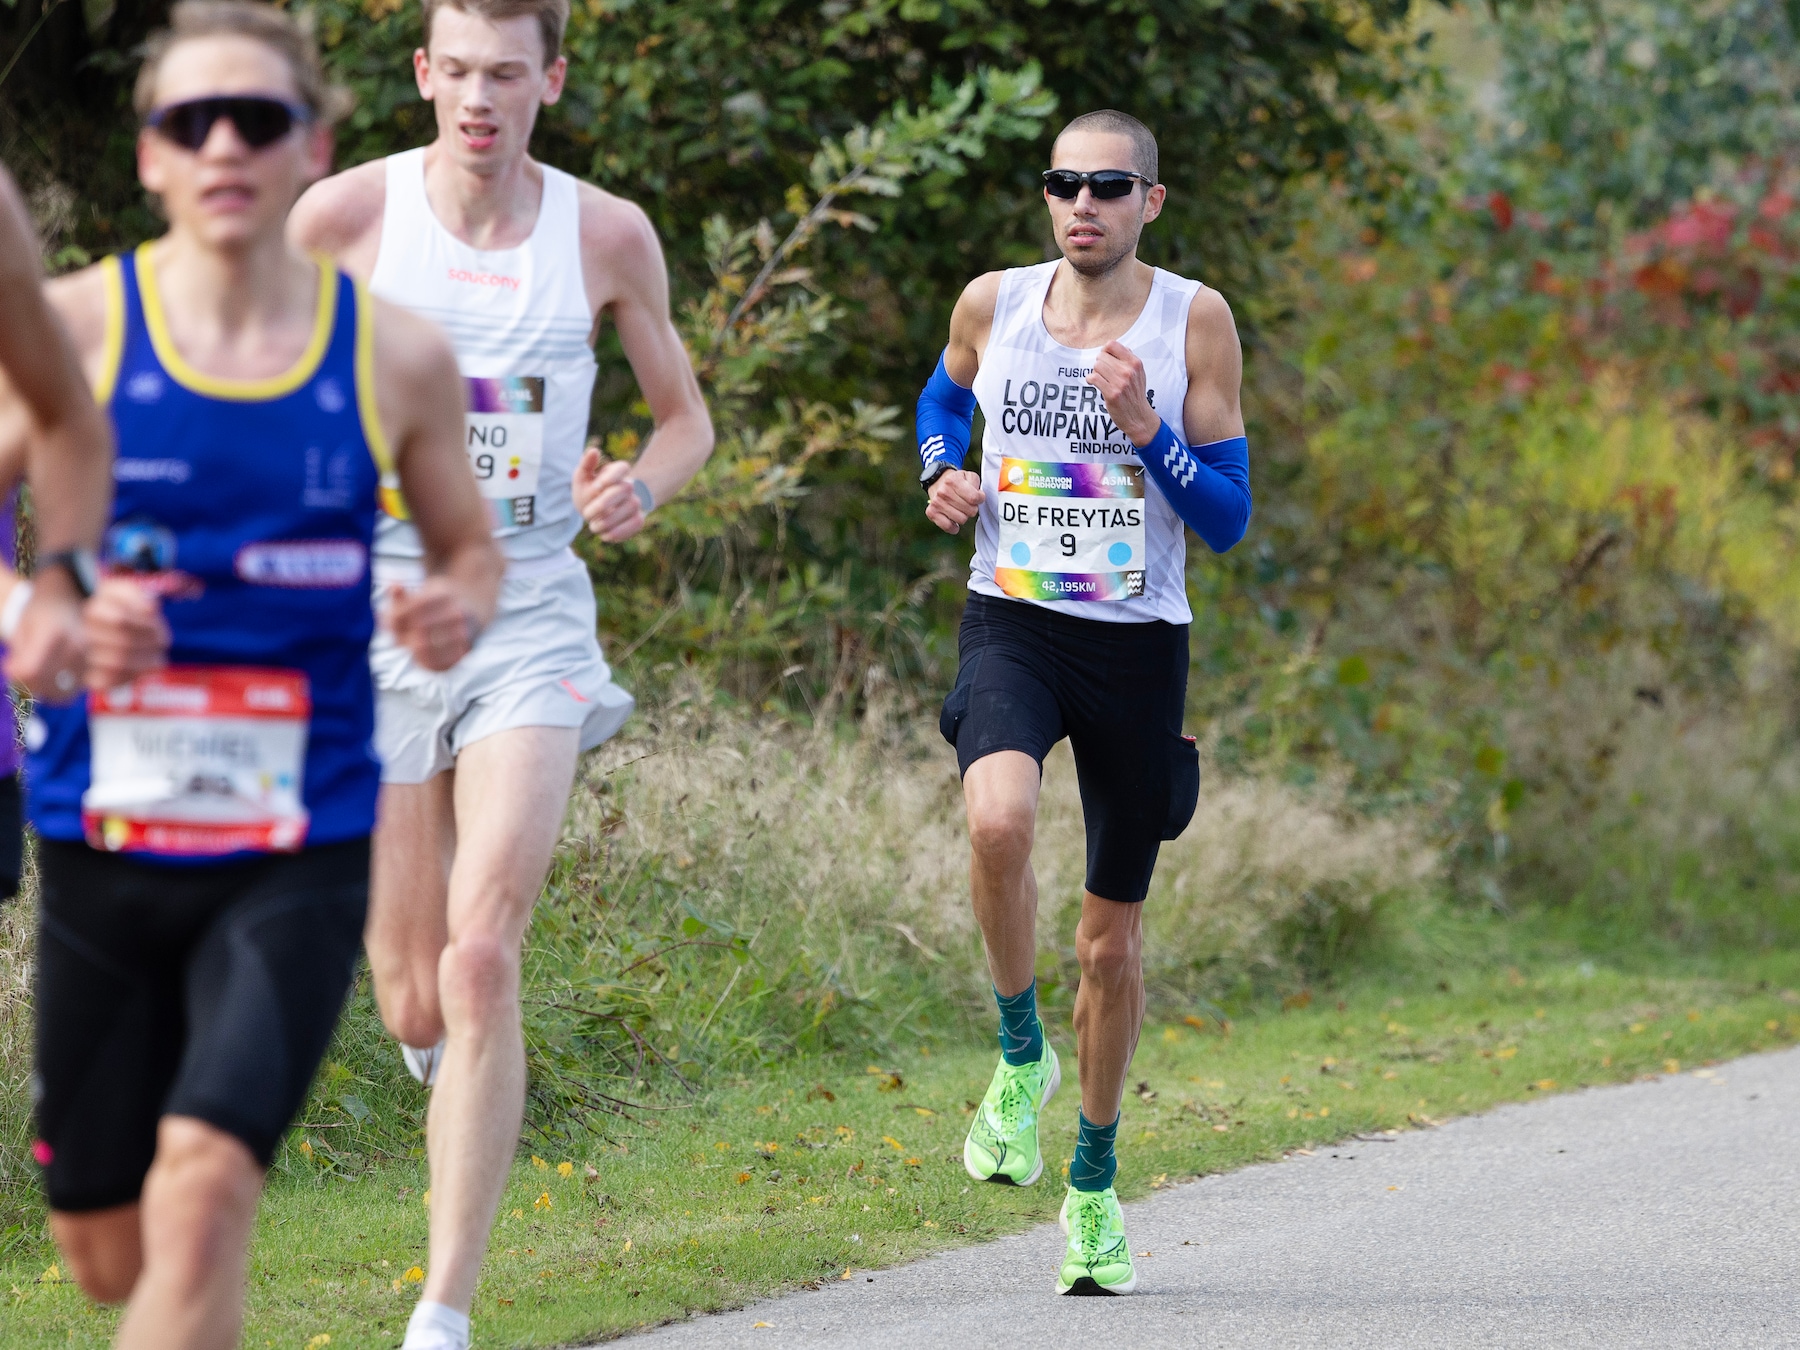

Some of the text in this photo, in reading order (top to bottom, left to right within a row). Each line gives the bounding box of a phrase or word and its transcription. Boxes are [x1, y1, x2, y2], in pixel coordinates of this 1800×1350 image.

[447, 266, 521, 292] saucony
[1058, 367, 1094, 378] FUSIO
[1002, 407, 1114, 441] COMPANY
[1070, 442, 1138, 455] EINDHOVE
[1028, 475, 1072, 484] MARATHON
[1028, 481, 1072, 490] EINDHOVEN
[1101, 476, 1134, 486] ASML
[1003, 502, 1141, 528] DE FREYTAS
[1060, 533, 1077, 557] 9
[1041, 580, 1096, 593] 42,195KM
